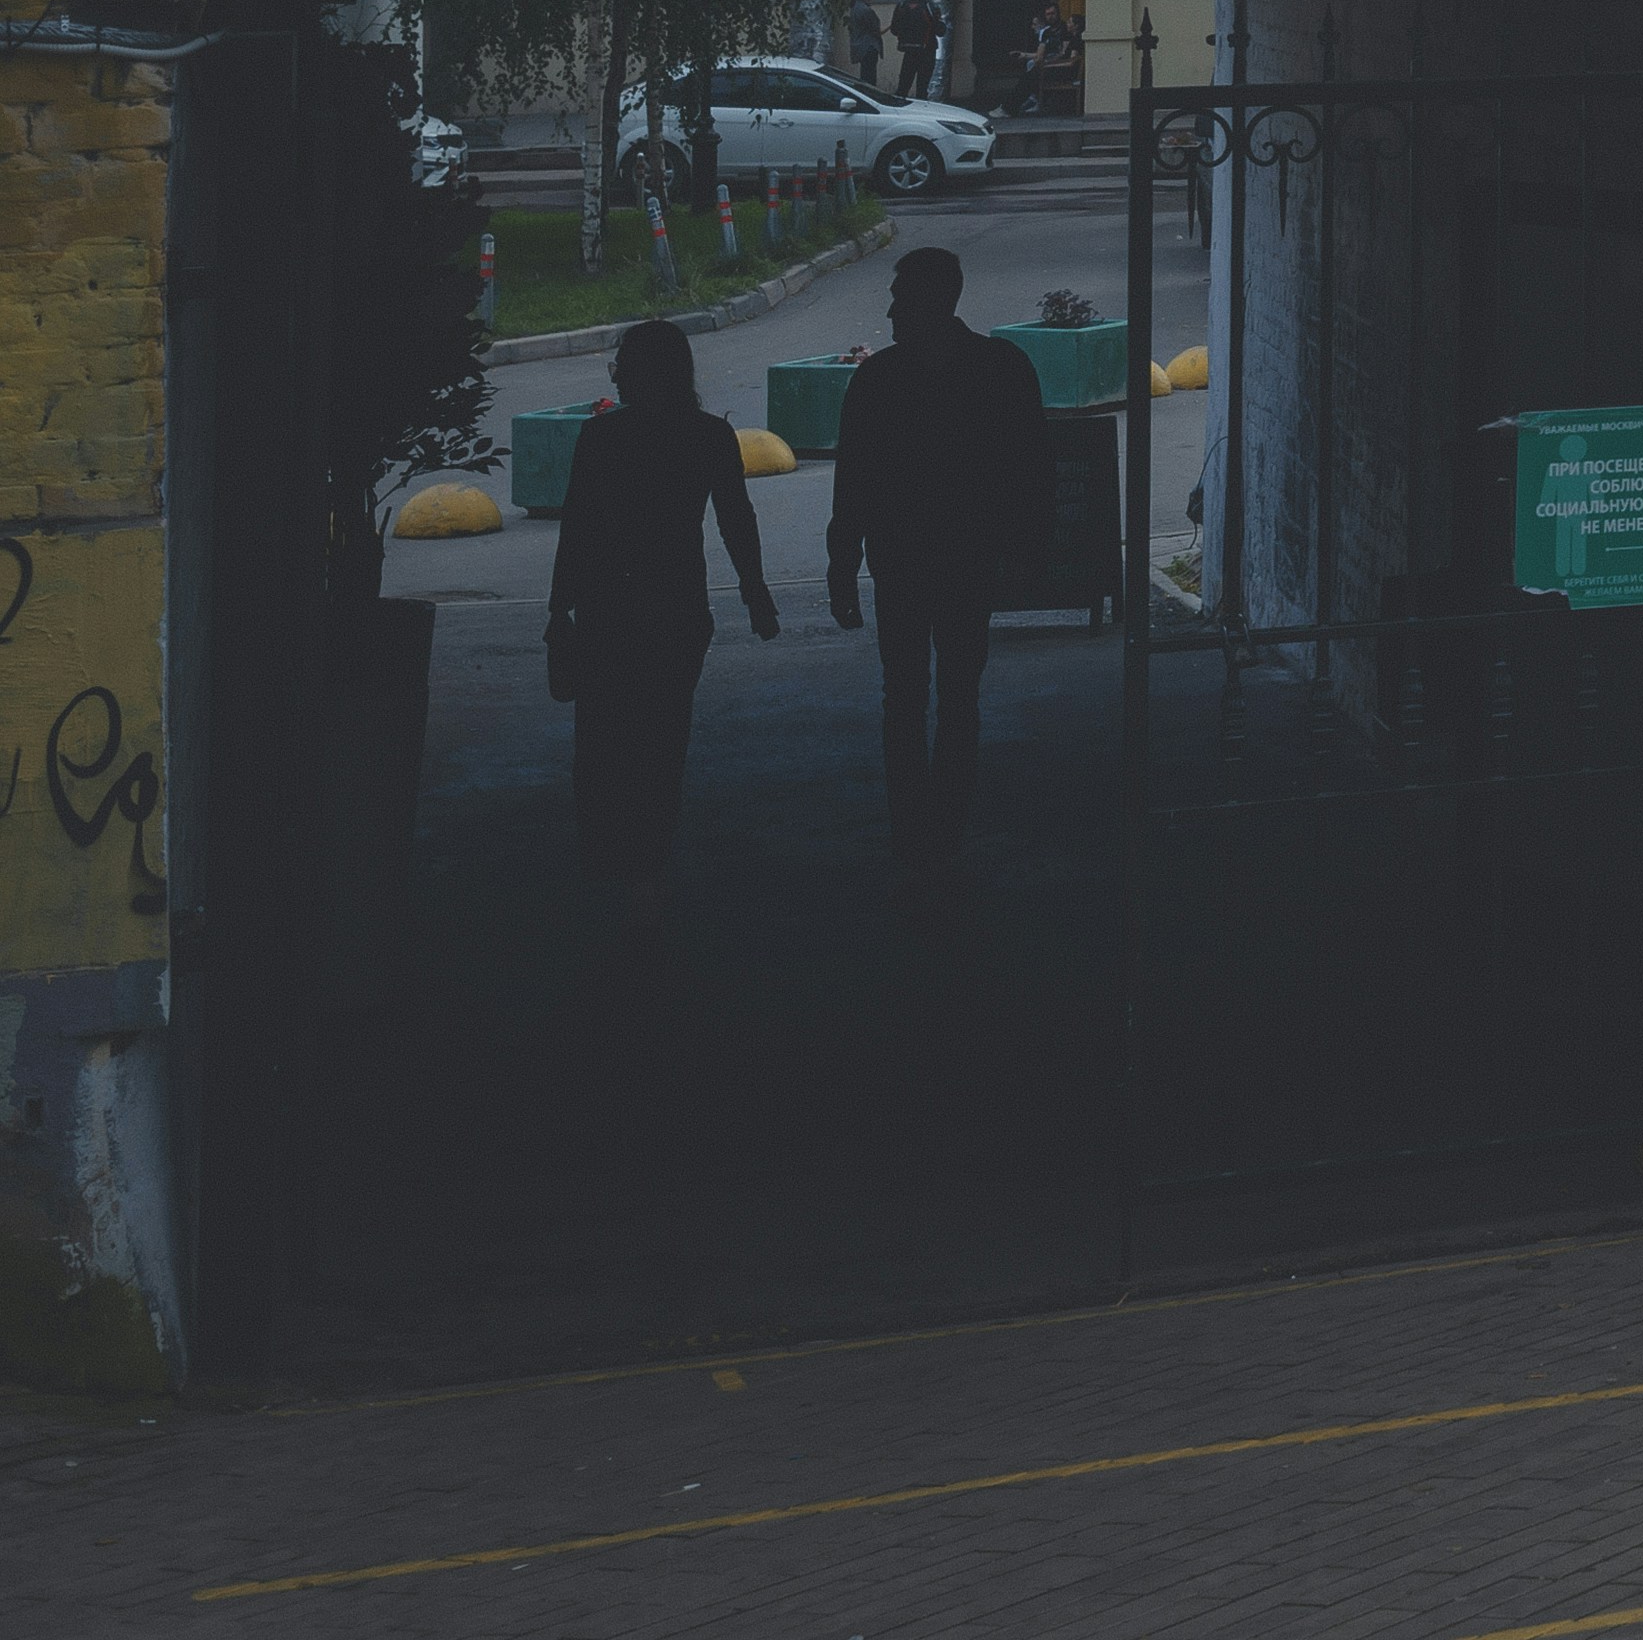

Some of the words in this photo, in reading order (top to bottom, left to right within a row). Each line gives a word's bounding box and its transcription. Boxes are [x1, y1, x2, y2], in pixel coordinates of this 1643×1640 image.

[1539, 423, 1598, 435] УВАЖАЕМЫЕ
[1549, 462, 1579, 477] ПРИ
[1536, 498, 1643, 519] СОЦИАЛЬНУЮ
[1581, 521, 1600, 535] НЕ
[1564, 576, 1606, 588] БЕРЕГИТЕ
[1608, 574, 1628, 586] СЕБЯ
[1630, 574, 1638, 584] И
[1621, 584, 1643, 595] ВАМ
